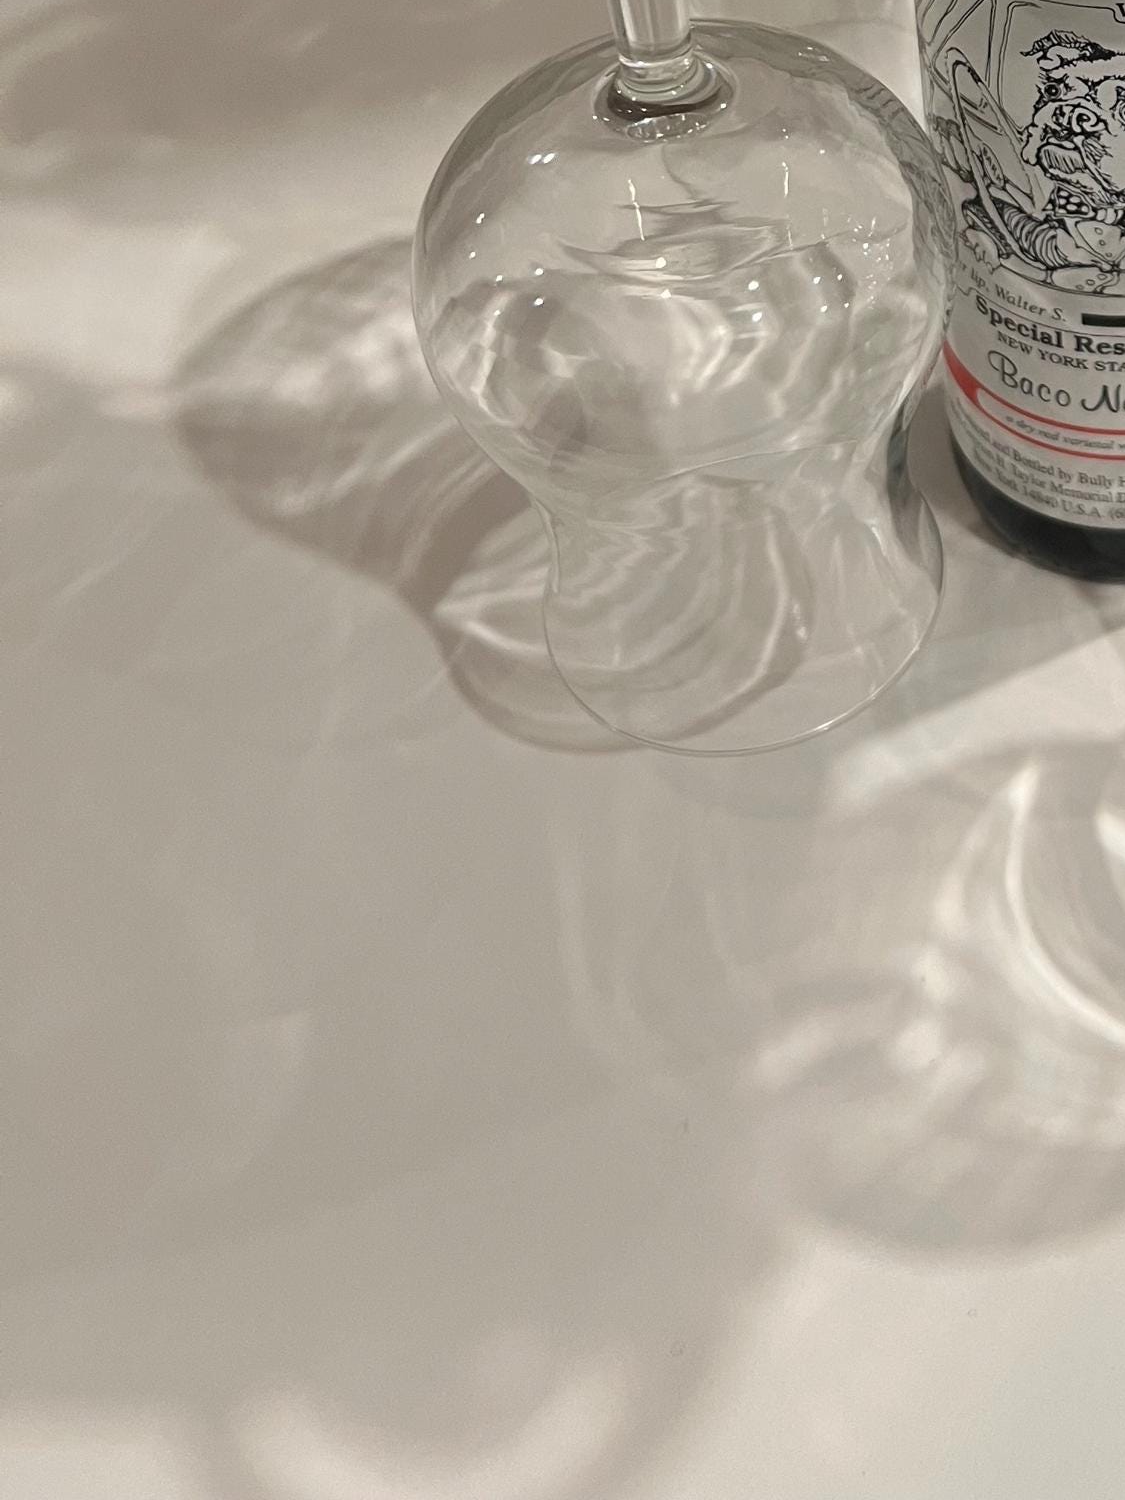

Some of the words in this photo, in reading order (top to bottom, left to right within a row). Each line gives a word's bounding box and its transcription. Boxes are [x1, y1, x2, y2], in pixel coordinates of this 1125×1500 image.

[975, 295, 1064, 349] Special
[995, 283, 1048, 317] Walter
[1051, 307, 1067, 322] S.
[997, 331, 1034, 356] NEW
[1037, 348, 1090, 371] YORK
[987, 350, 1072, 408] Baco
[1016, 419, 1035, 434] dry
[1038, 428, 1061, 441] red
[1010, 461, 1047, 489] Taylor
[1050, 481, 1112, 502] Memorial
[1012, 447, 1055, 477] Bottled
[1058, 467, 1073, 483] by
[1077, 471, 1114, 488] Bully
[1062, 499, 1105, 519] U.S.A.
